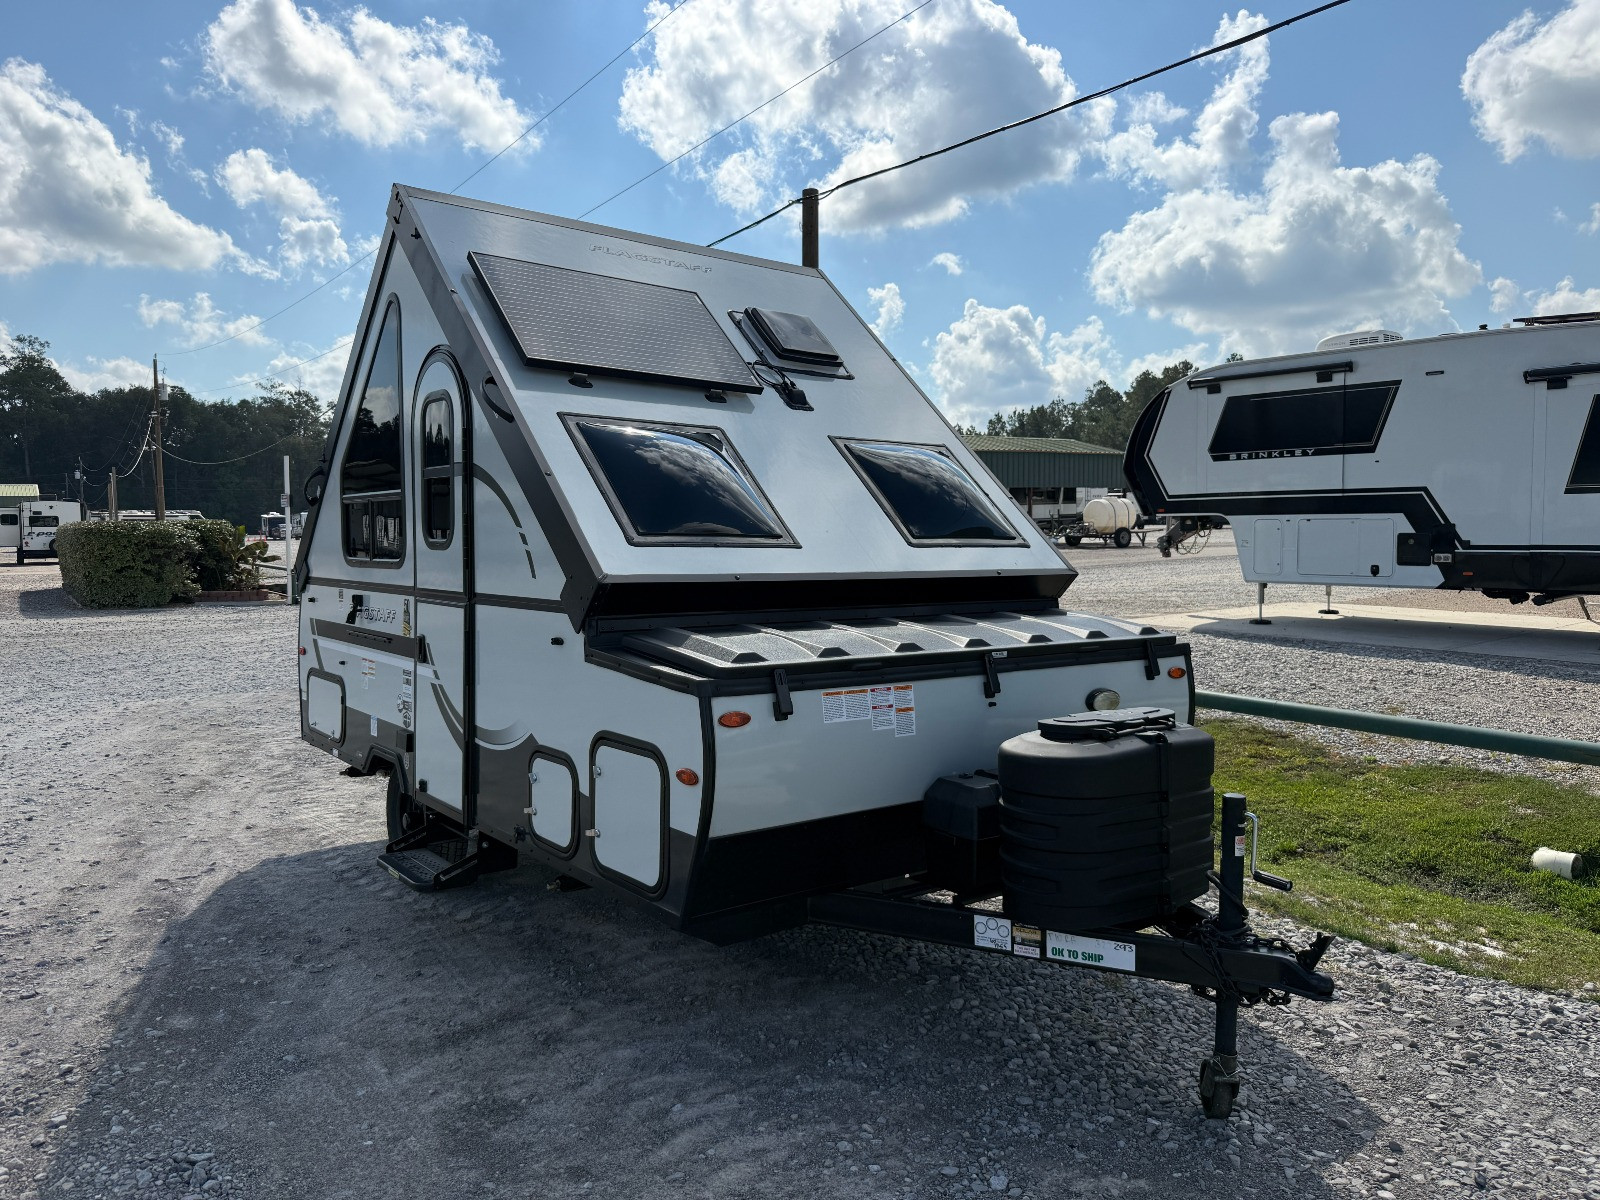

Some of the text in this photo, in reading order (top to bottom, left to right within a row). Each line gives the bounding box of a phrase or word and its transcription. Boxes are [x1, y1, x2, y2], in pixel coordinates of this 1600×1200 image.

[589, 243, 712, 273] FLAGSTAFF
[1229, 448, 1315, 461] BRINKLEY
[1051, 946, 1065, 957] OK
[1067, 948, 1079, 960] TO
[1081, 951, 1104, 963] SHIP
